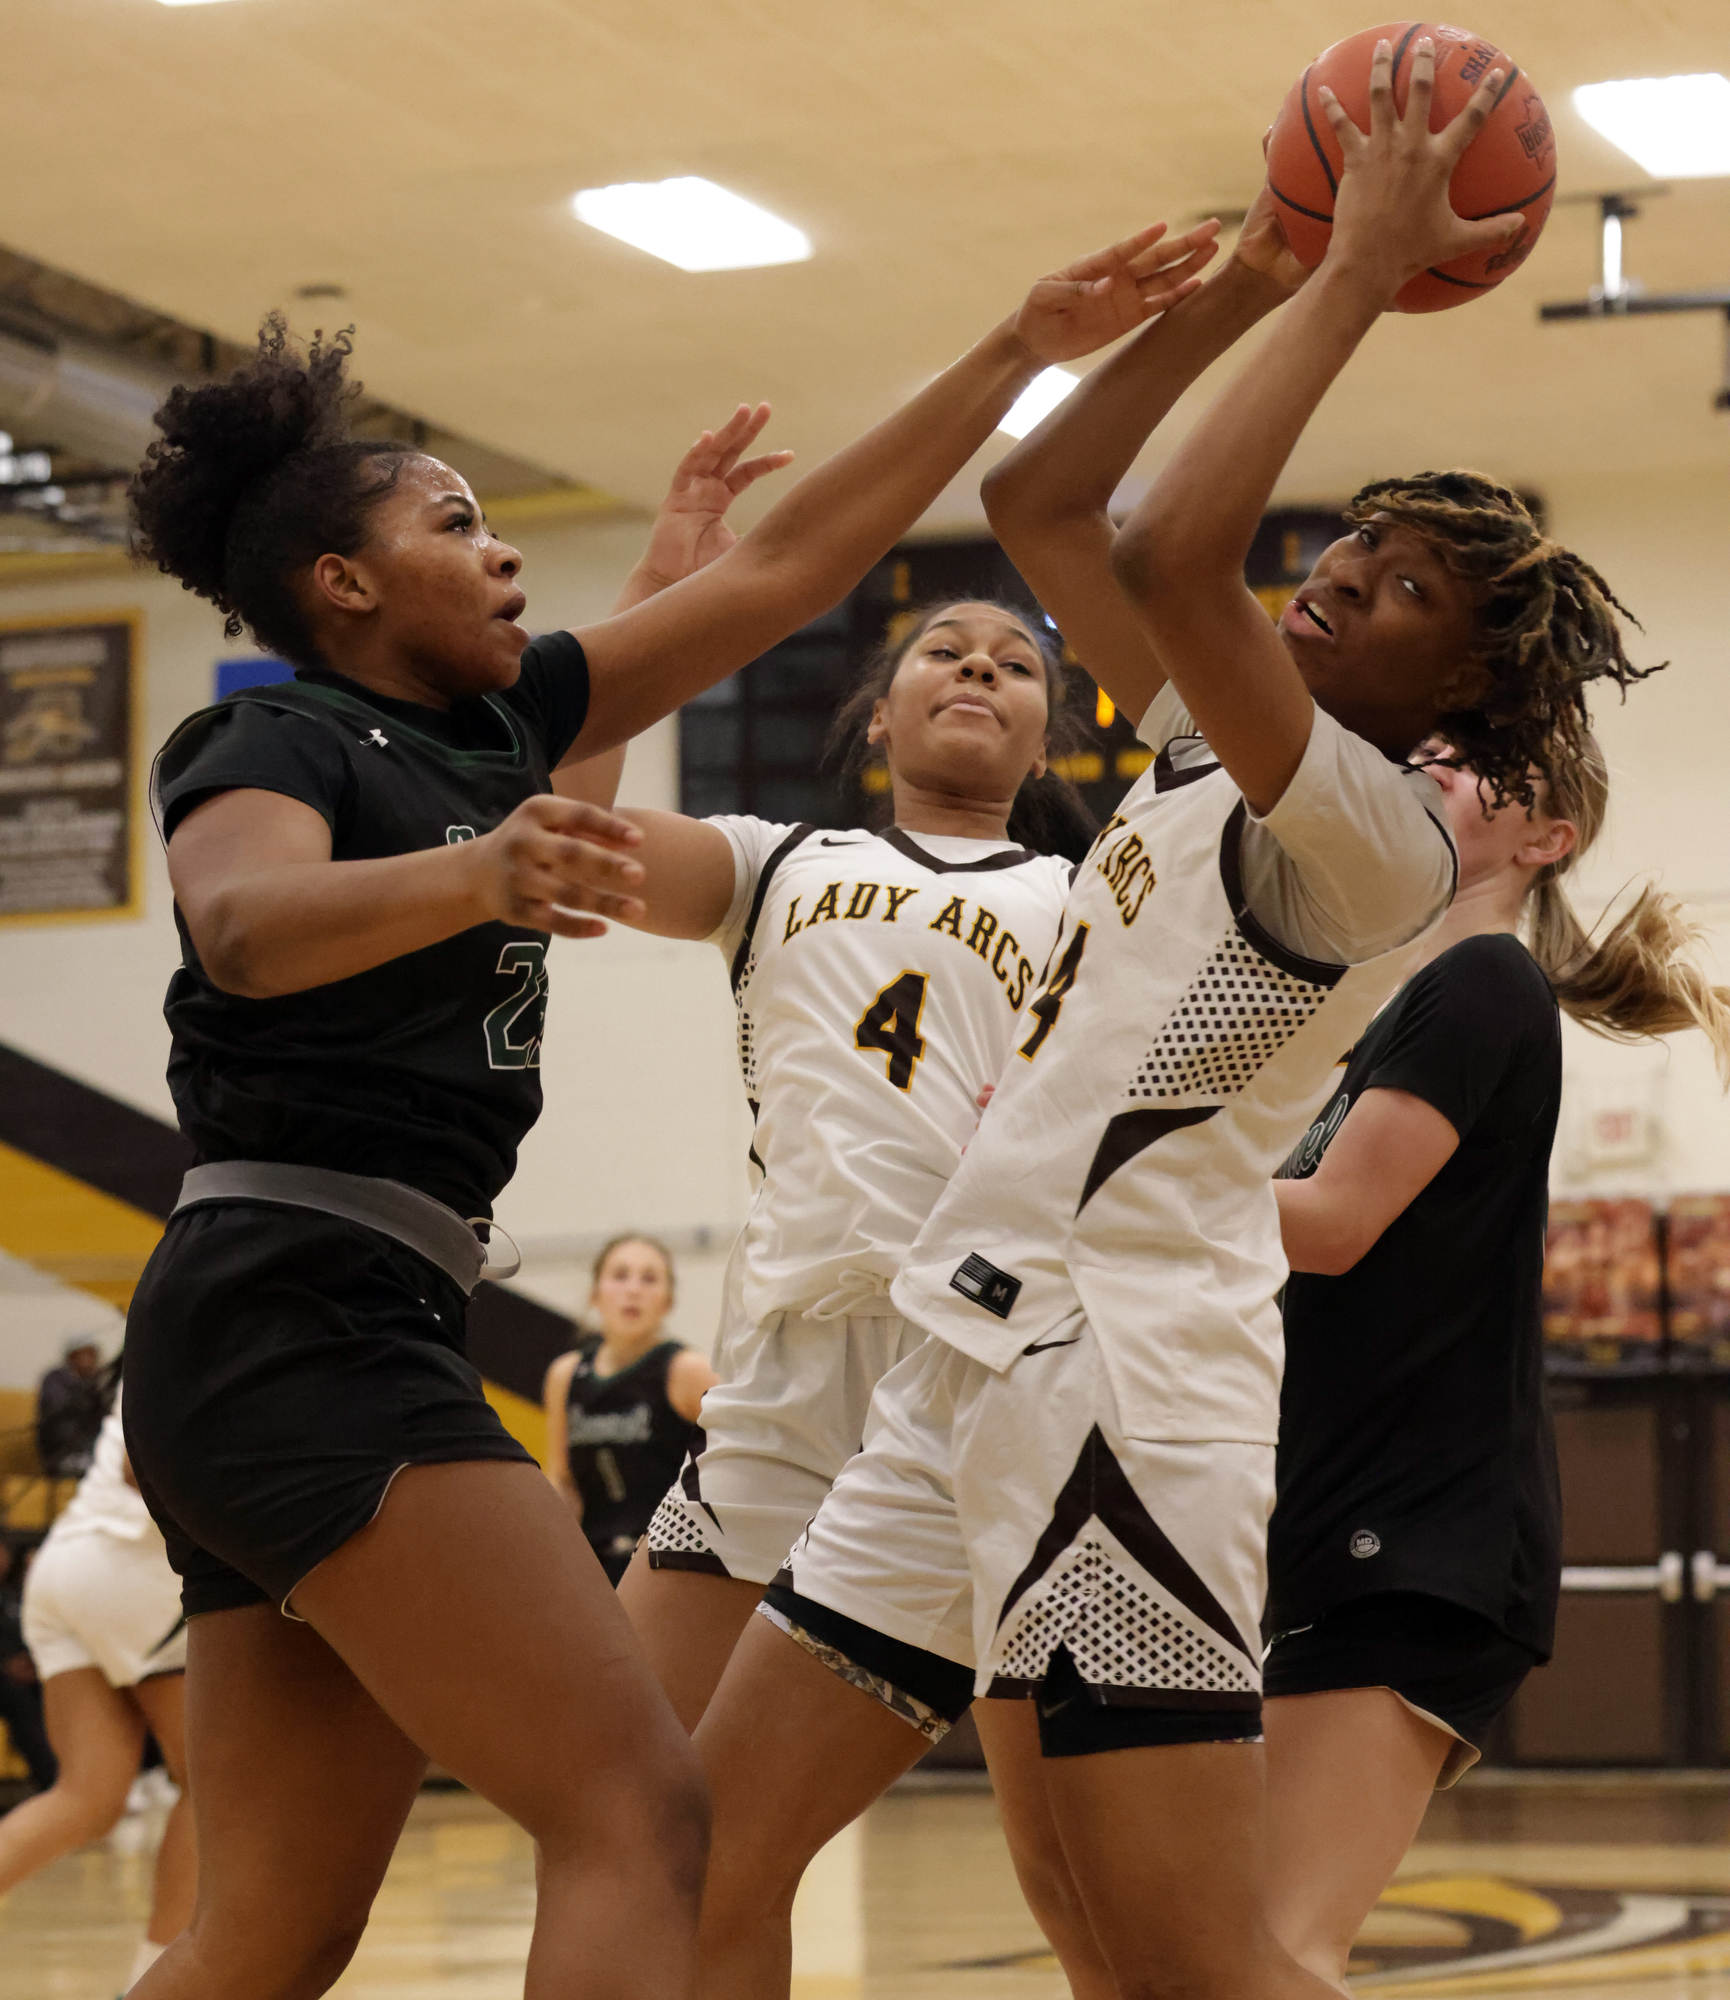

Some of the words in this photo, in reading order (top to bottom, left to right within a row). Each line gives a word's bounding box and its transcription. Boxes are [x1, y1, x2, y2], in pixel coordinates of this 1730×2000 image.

[782, 881, 920, 947] LADY
[928, 894, 1034, 1013] ARCS
[1017, 907, 1092, 1064] 4
[853, 969, 931, 1094] 4
[991, 1283, 1009, 1302] M
[1356, 1537, 1373, 1546] MD
